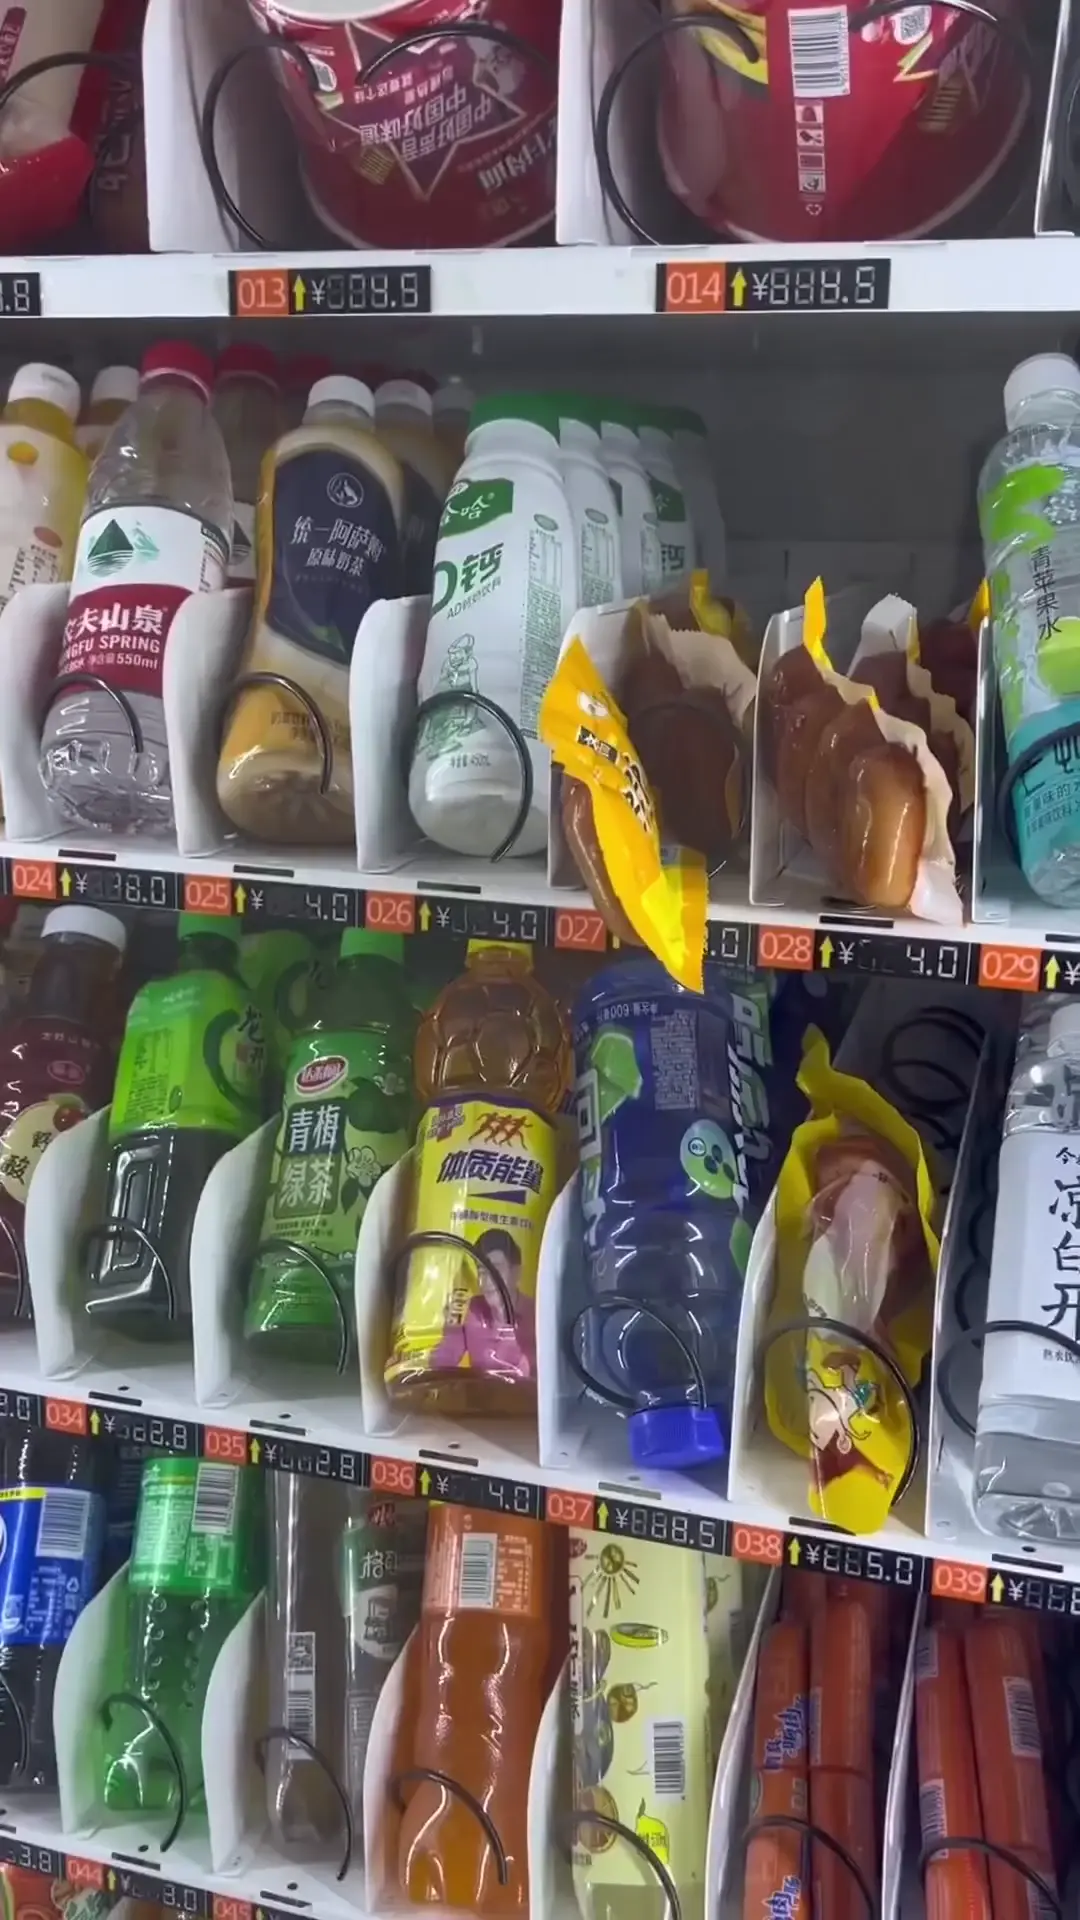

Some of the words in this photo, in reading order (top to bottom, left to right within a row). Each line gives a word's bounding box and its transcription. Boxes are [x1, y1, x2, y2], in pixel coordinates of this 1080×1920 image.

[358, 87, 468, 147] 中国好味道
[400, 90, 493, 163] 中国好声音
[238, 277, 286, 309] 013
[667, 272, 722, 304] 014
[306, 546, 365, 578] 原味奶茶
[1031, 545, 1063, 640] 青苹果水
[99, 634, 161, 654] SPRING
[13, 865, 54, 892] 024
[185, 884, 230, 911] 025
[365, 900, 412, 927] 026
[556, 914, 604, 944] 027
[759, 931, 811, 964] 028
[981, 951, 1040, 983] 029
[288, 1103, 342, 1154] 青梅
[1055, 1146, 1080, 1165] 今
[279, 1157, 334, 1209] 绿茶
[436, 1149, 544, 1195] 体质能量
[46, 1403, 84, 1428] 034
[205, 1431, 245, 1458] 035
[371, 1460, 414, 1489] 036
[549, 1493, 593, 1523] 037
[734, 1527, 782, 1559] 038
[935, 1565, 986, 1596] 039
[67, 1858, 103, 1885] 044
